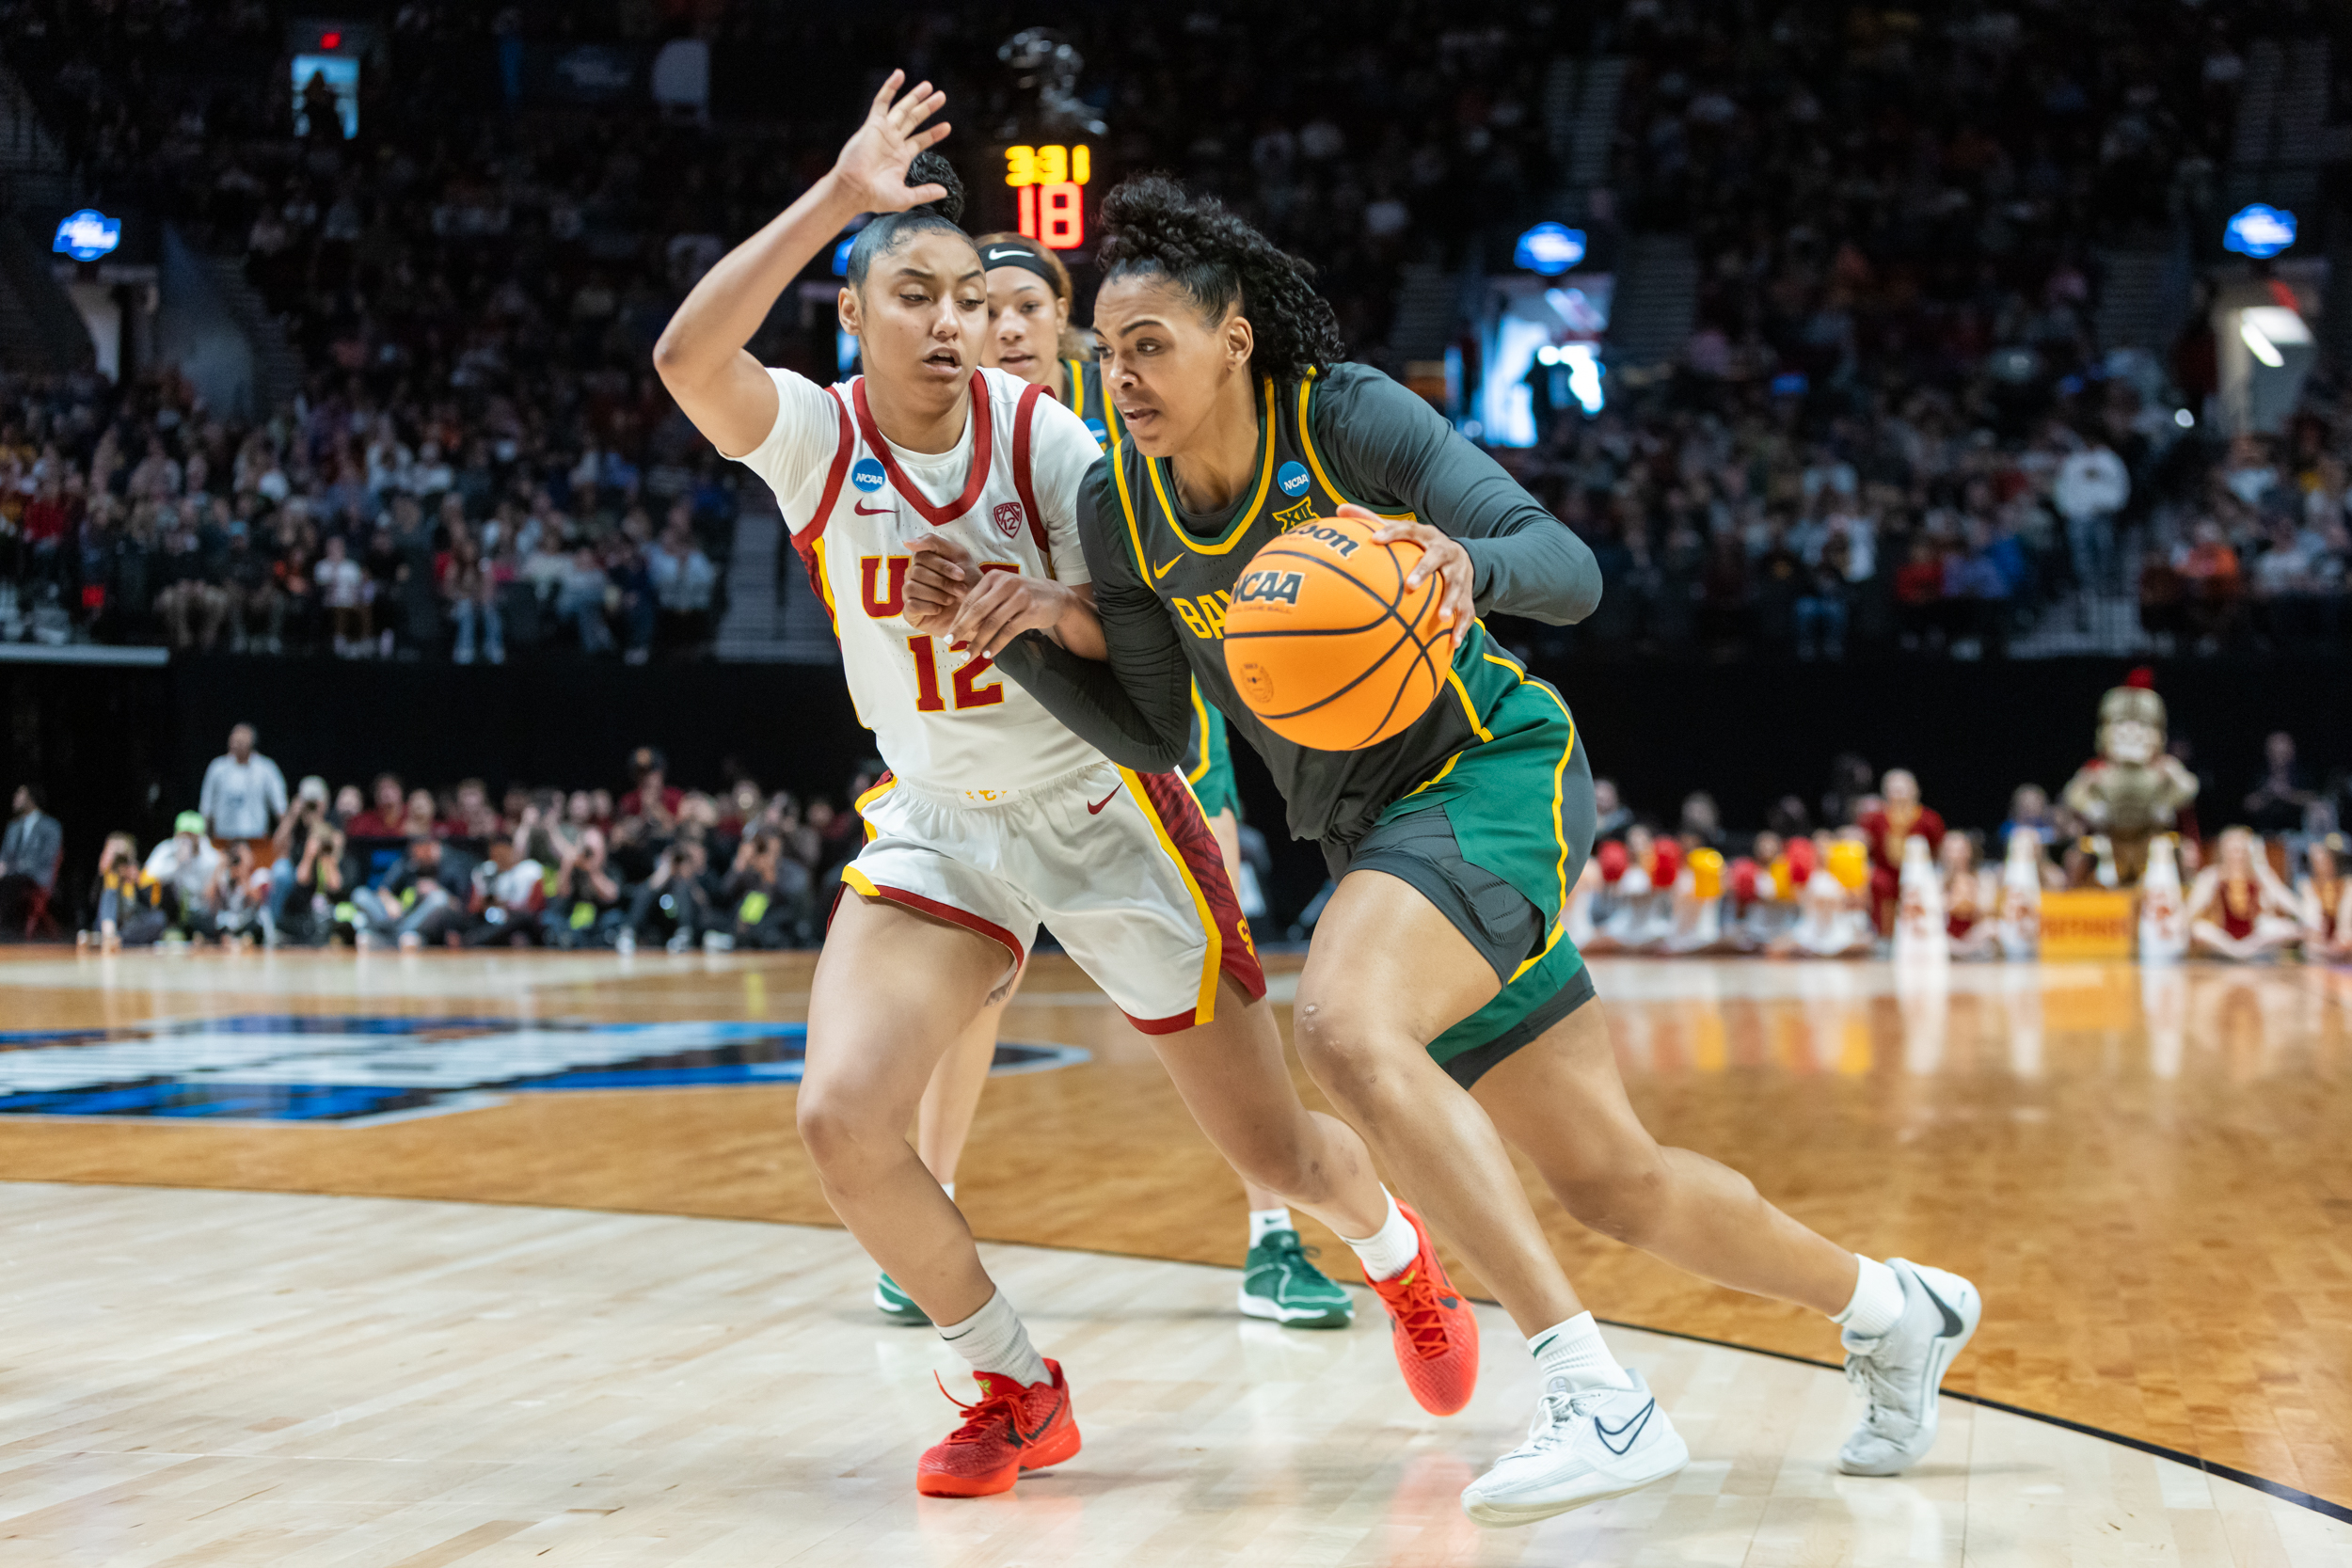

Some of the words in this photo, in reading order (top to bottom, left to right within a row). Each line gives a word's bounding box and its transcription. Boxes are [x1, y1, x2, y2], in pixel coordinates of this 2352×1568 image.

[1018, 180, 1084, 249] 18
[856, 472, 883, 485] NCAA
[1283, 473, 1310, 491] NCAA
[995, 502, 1022, 525] PAC
[1003, 516, 1017, 531] 12
[907, 633, 1005, 713] 12
